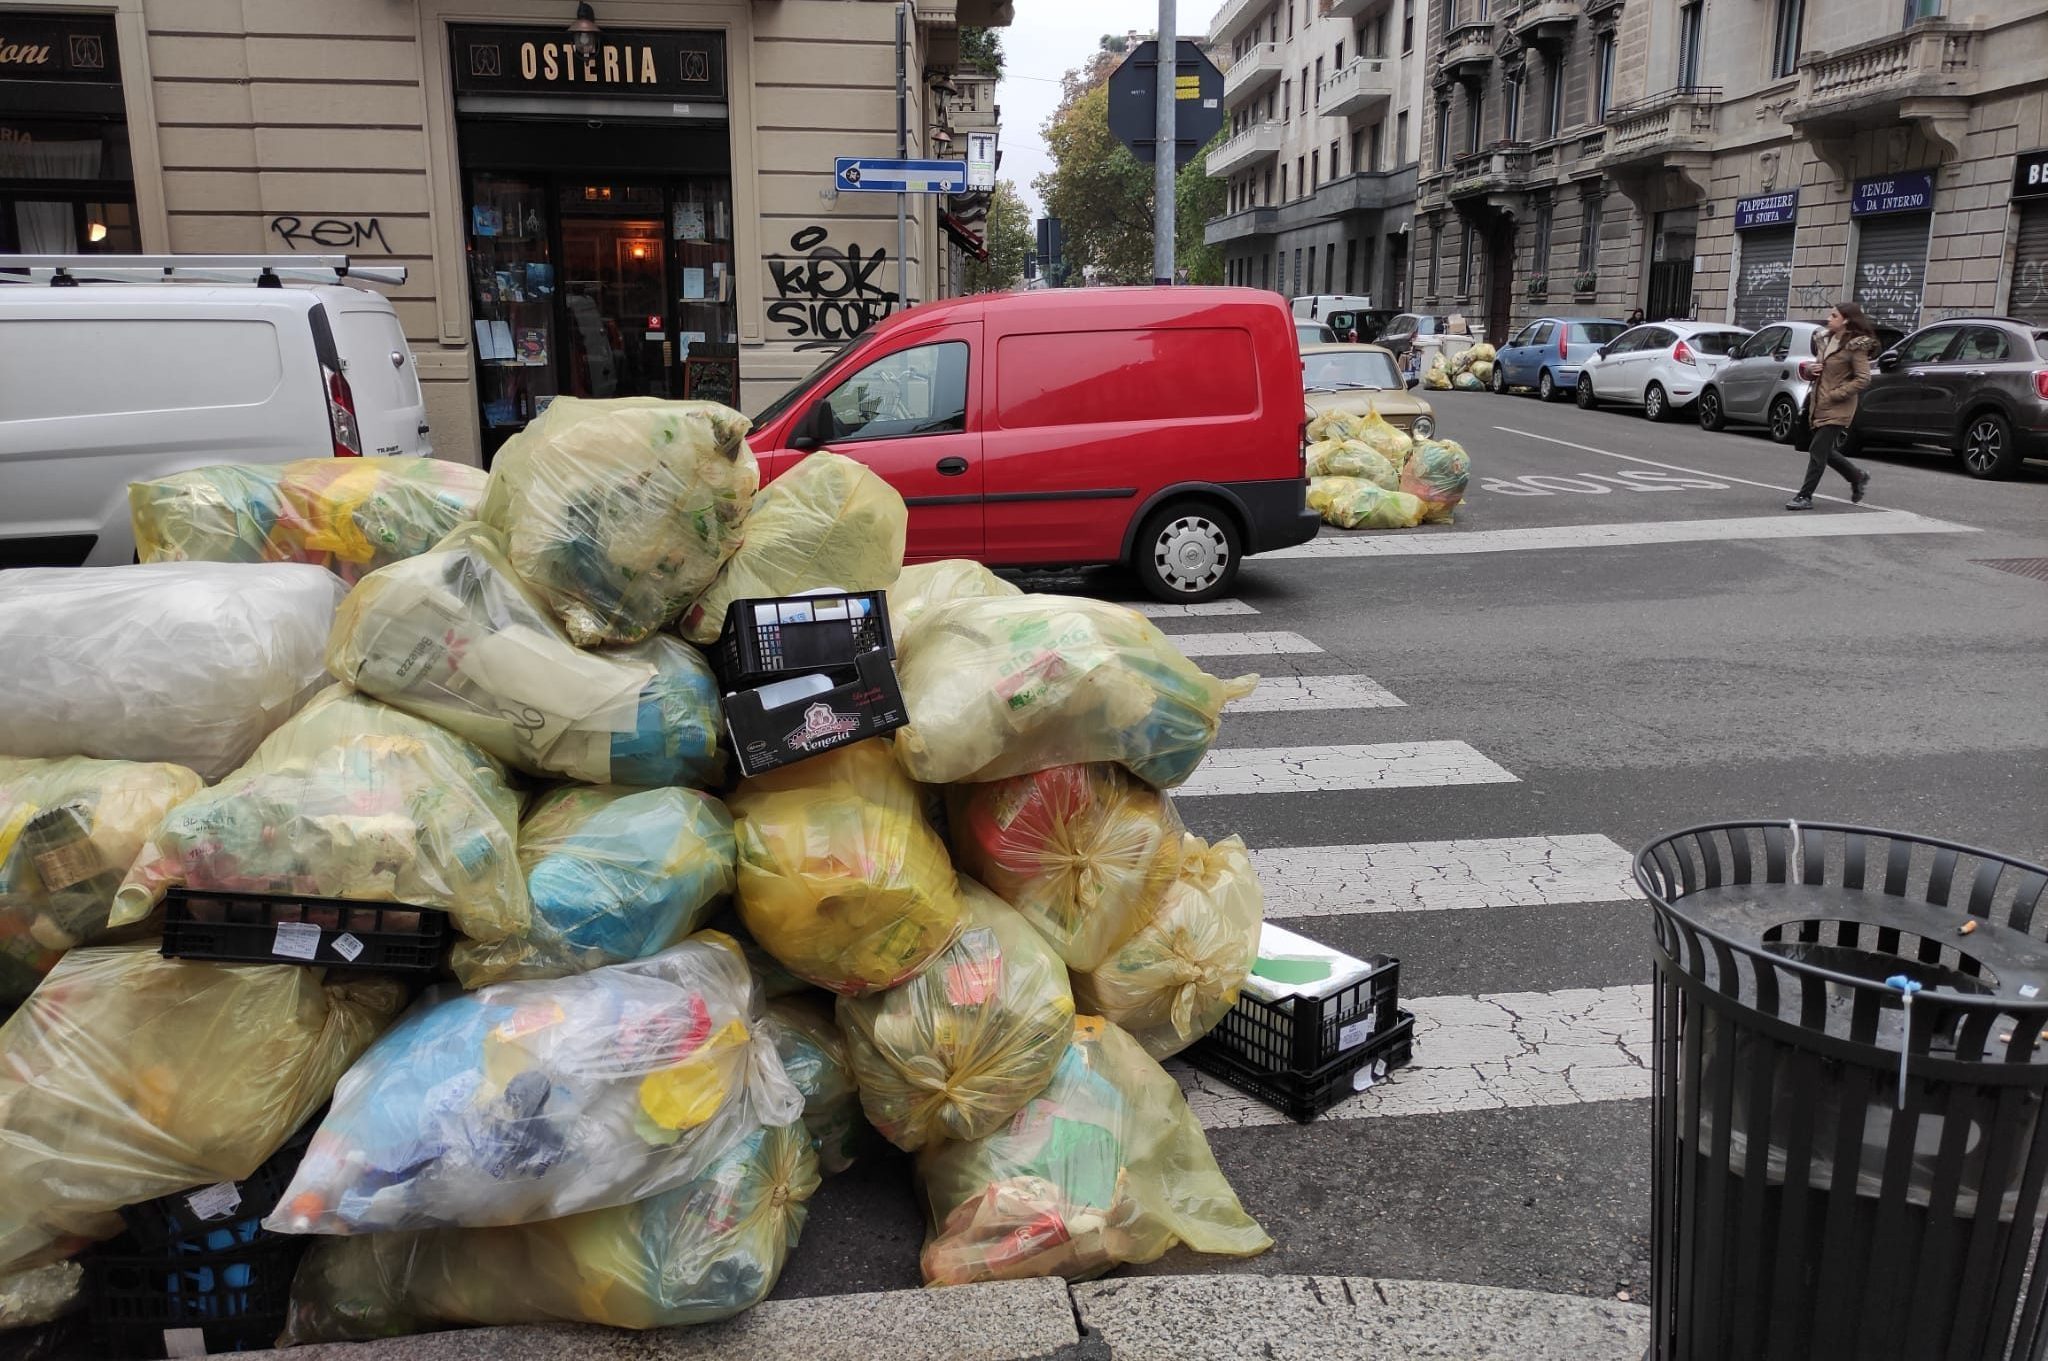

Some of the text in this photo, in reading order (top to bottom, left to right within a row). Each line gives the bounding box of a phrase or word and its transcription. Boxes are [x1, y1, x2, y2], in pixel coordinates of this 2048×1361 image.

[521, 42, 657, 83] OSTERIA
[1861, 181, 1895, 197] TENDE
[1743, 194, 1793, 212] TAPPEZZIERE
[1866, 193, 1923, 211] DA INTERNO
[1744, 213, 1753, 224] IN
[1480, 470, 1731, 496] STOP
[801, 730, 851, 752] Venezia
